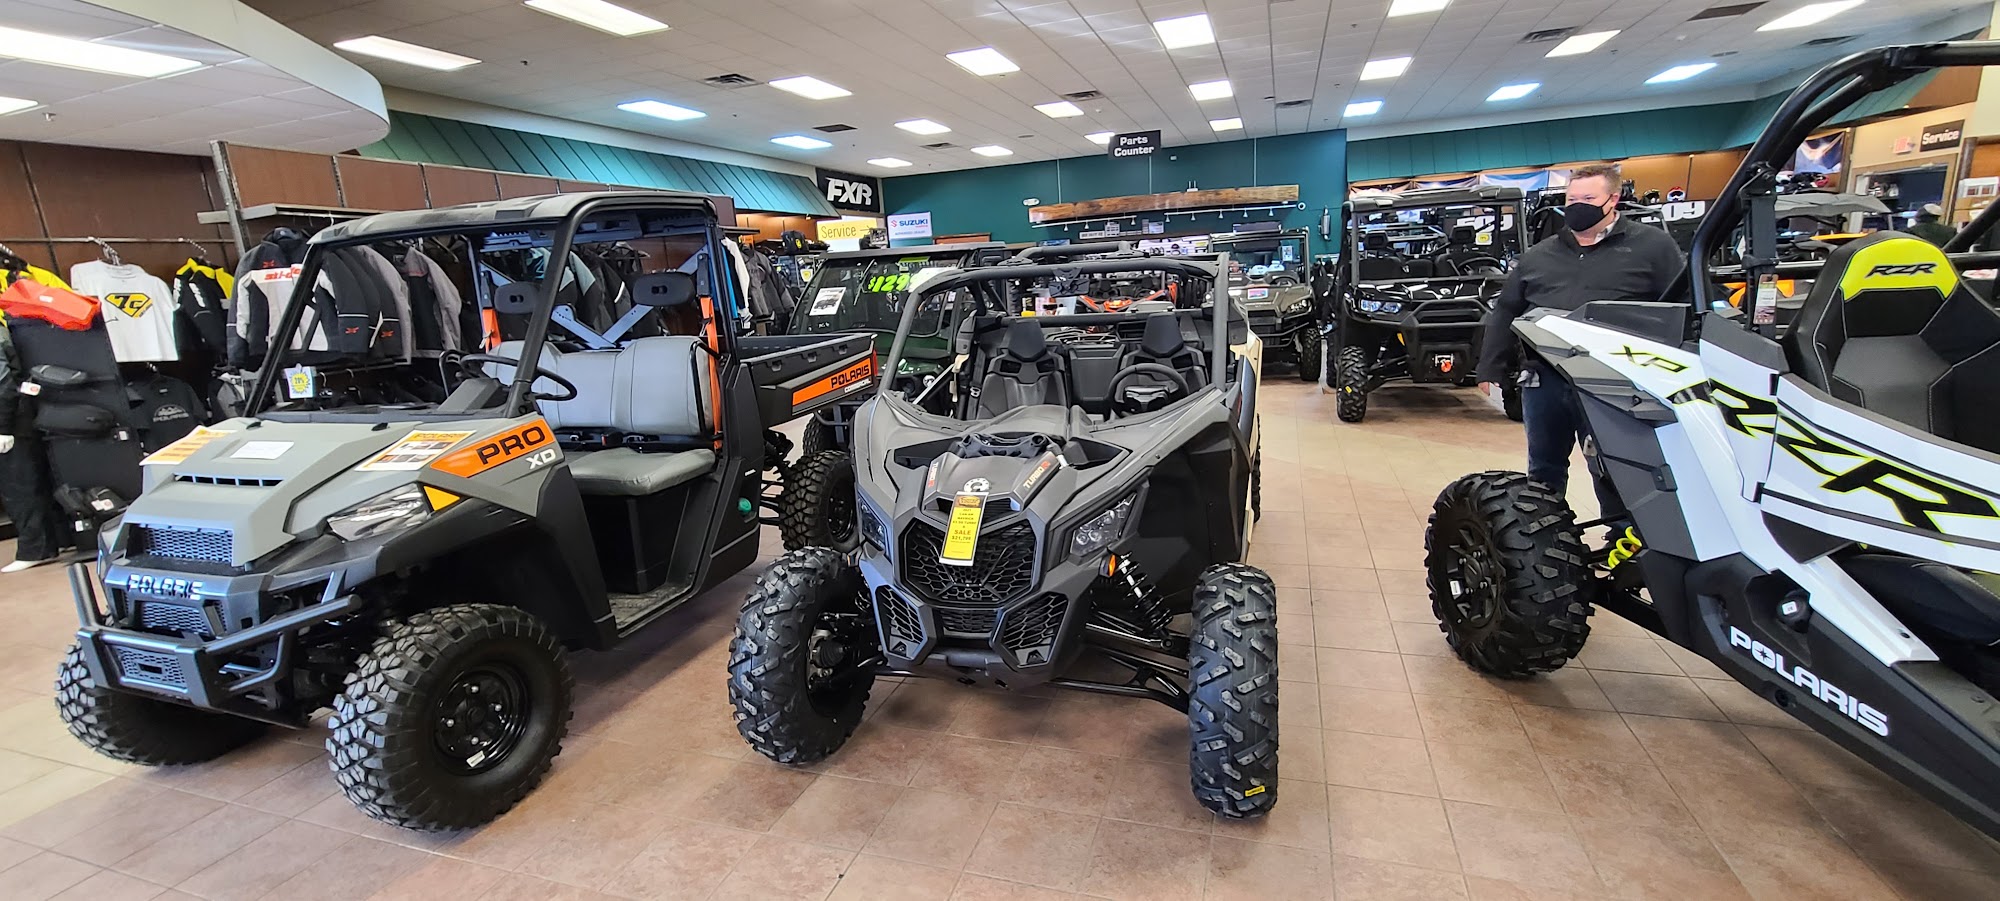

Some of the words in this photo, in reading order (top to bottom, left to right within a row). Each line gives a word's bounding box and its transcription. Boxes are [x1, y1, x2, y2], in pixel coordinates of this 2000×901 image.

[1120, 136, 1148, 146] Parts
[1921, 129, 1960, 145] Service
[1114, 146, 1155, 157] Counter
[825, 177, 873, 205] FXR
[821, 225, 857, 239] Service
[899, 219, 928, 227] SUZUKI
[1863, 263, 1937, 279] RZR
[830, 364, 870, 388] POLARIS
[475, 426, 547, 466] PRO
[525, 448, 556, 470] XD
[1665, 378, 2000, 540] RZR
[128, 574, 204, 601] POLARIS
[1729, 625, 1889, 737] POLARIS
